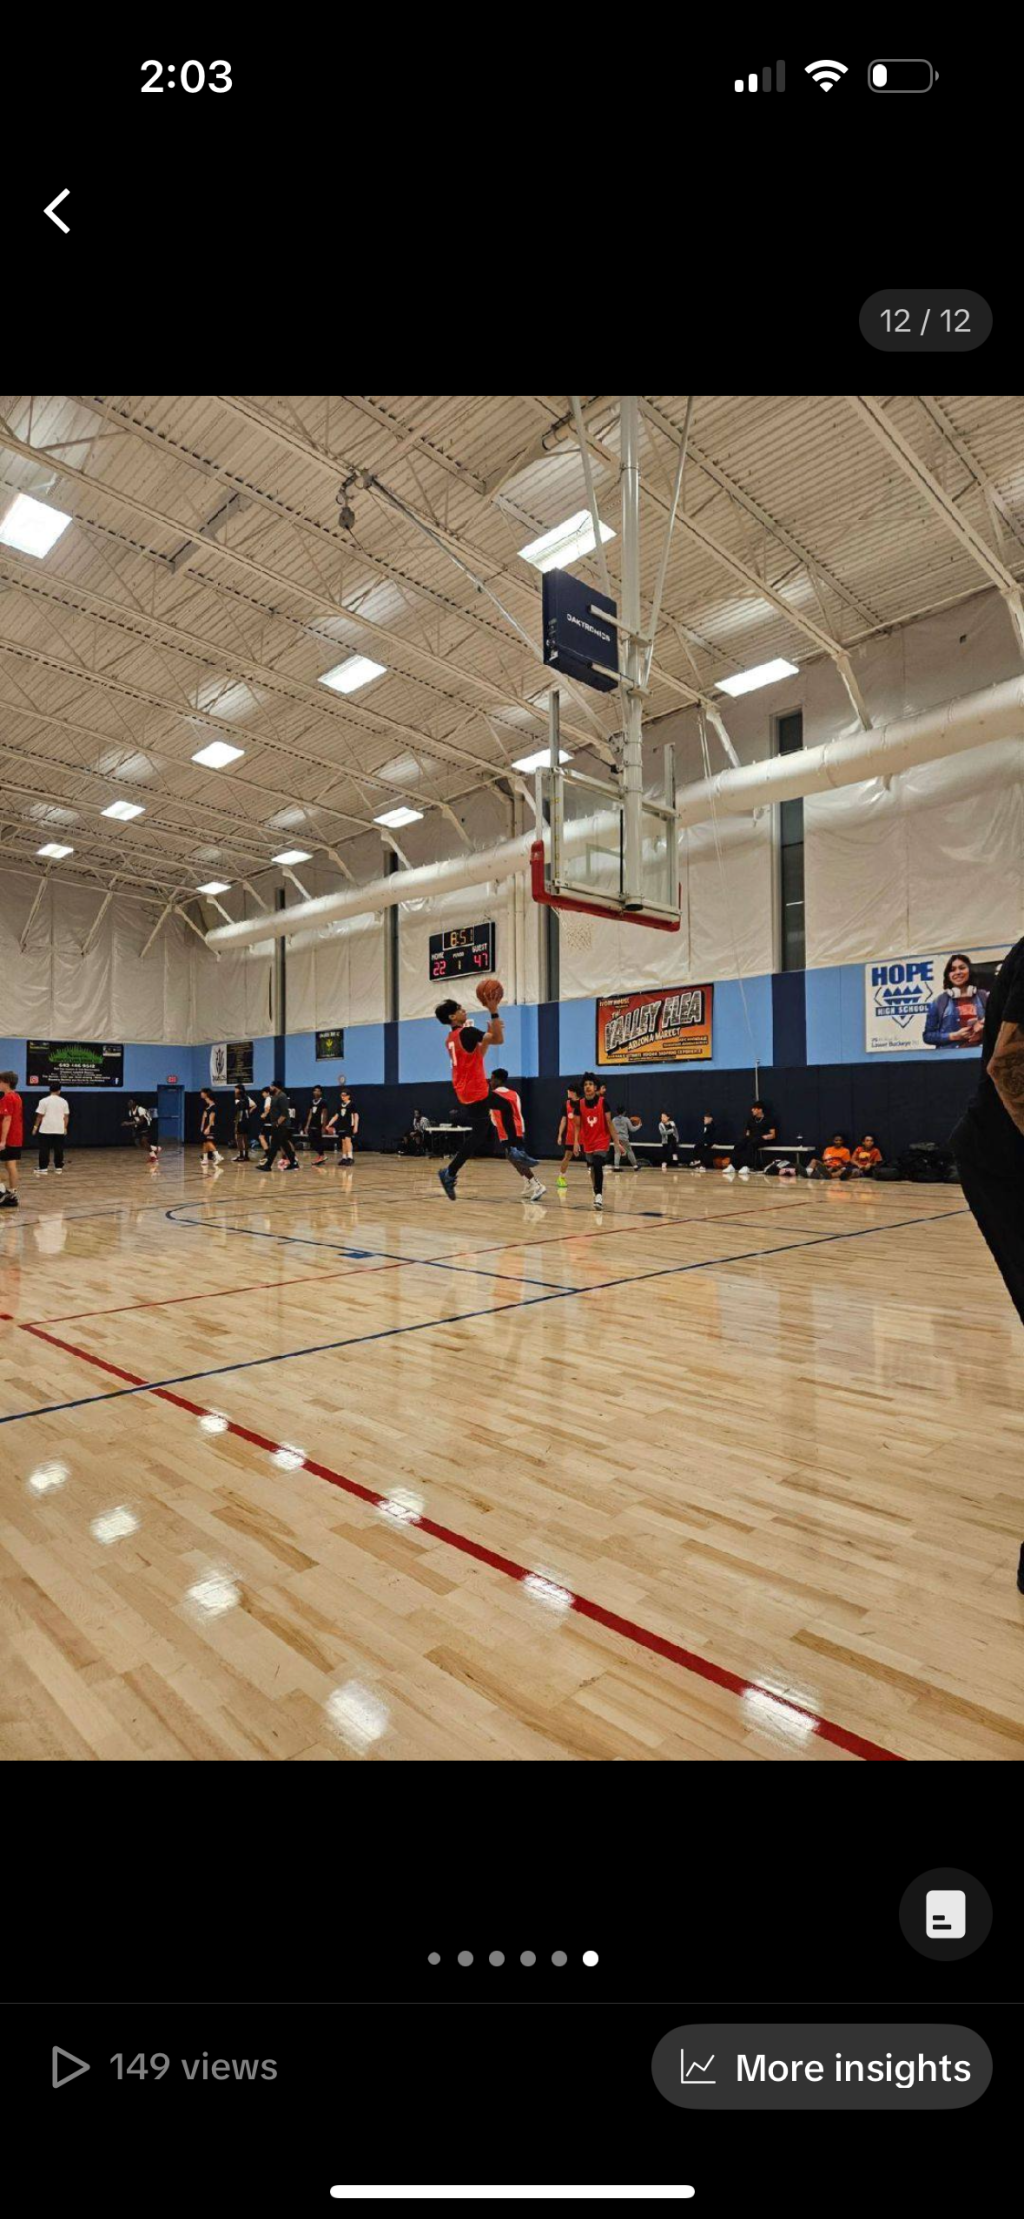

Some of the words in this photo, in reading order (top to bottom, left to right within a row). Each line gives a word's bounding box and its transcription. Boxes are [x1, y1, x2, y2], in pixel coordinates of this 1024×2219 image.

[566, 613, 611, 642] DAKTRONICS
[431, 952, 444, 960] HOME
[474, 952, 488, 967] 47
[433, 960, 447, 976] 22
[872, 960, 934, 987] HOPE
[877, 1006, 895, 1015] HIGH
[897, 1004, 929, 1014] SCHOOL
[605, 1001, 662, 1052] VALLEY
[661, 991, 702, 1029] FLEA
[627, 1035, 655, 1051] ARIZONA
[654, 1027, 681, 1042] MARKET
